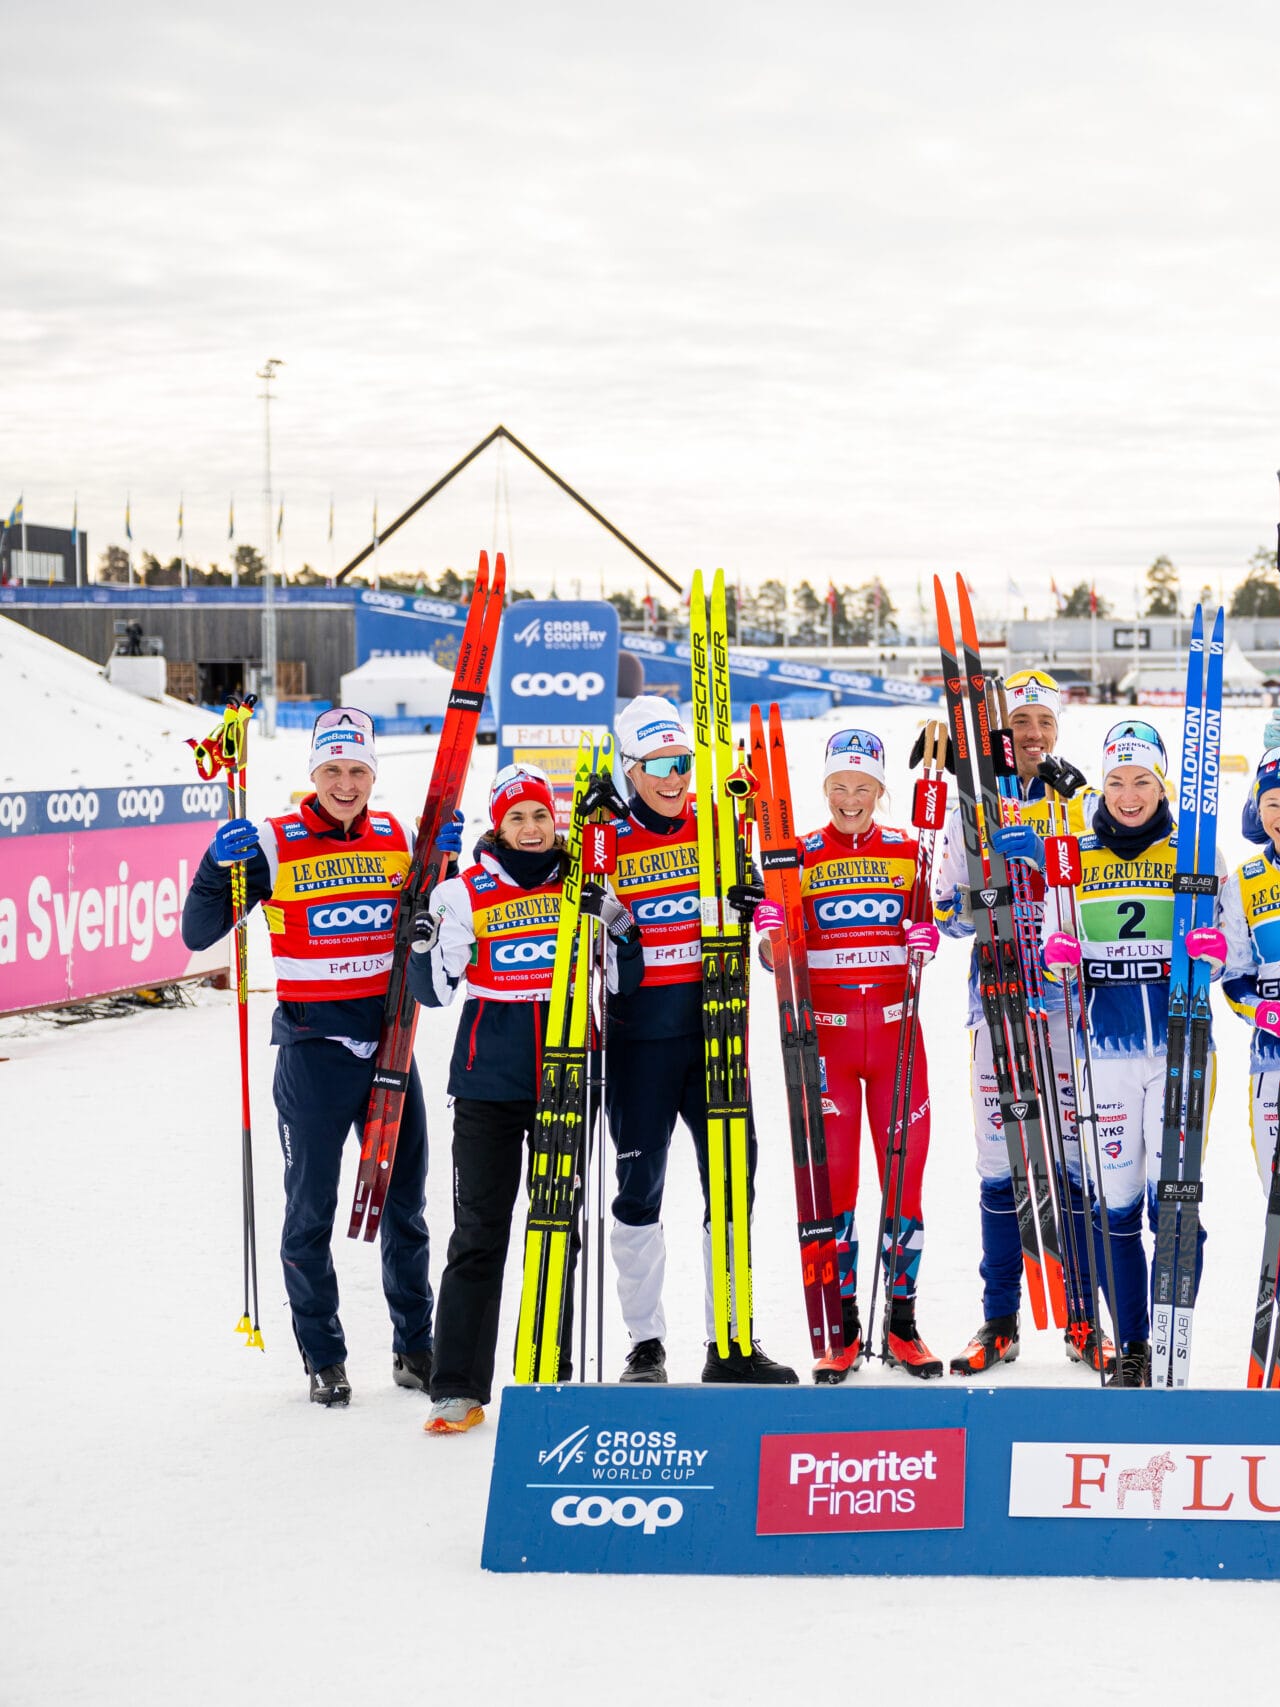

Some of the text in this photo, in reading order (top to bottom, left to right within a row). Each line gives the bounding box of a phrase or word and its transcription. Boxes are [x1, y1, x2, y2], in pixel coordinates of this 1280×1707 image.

[544, 620, 590, 633] CROSS
[544, 631, 607, 643] COUNTRY
[545, 642, 603, 651] WORLD CUP
[458, 642, 472, 684] ATOMIC
[474, 644, 489, 686] ATOMIC
[511, 671, 605, 701] coop
[694, 632, 709, 749] FISCHER
[713, 630, 730, 747] FISCHER
[456, 696, 479, 707] ATOMIC
[637, 721, 679, 741] SpareBank
[958, 702, 968, 760] ROSSIGNOL
[980, 698, 992, 757] ROSSIGNOL
[315, 732, 355, 750] SpareBank
[1182, 706, 1200, 812] SALOMON
[1202, 709, 1221, 816] SALOMON
[47, 784, 223, 828] coop coop coop
[778, 798, 791, 840] ATOMIC
[760, 800, 773, 841] ATOMIC
[292, 853, 386, 882] LE GRUYÈRE
[618, 845, 700, 877] LE GRUYÈR
[770, 855, 796, 865] ATOMIC
[809, 857, 889, 883] LE GRUYÈRE
[1083, 858, 1173, 884] LE GRUYÈRE
[298, 875, 386, 893] SWITZERLAND
[809, 876, 889, 889] SWITZERLAND
[1086, 880, 1170, 892] SWITZERLAND
[27, 858, 189, 962] Sverige!
[486, 893, 562, 923] LE GRUYÈR
[818, 898, 901, 923] coop
[1252, 891, 1267, 907] LE
[312, 903, 395, 929] coop
[1116, 901, 1147, 940] 2
[308, 938, 320, 946] FIS
[340, 936, 370, 944] COUNTRY
[703, 940, 743, 949] FISCHER
[544, 1051, 586, 1059] FISCHER
[1099, 1126, 1124, 1138] LYKO
[616, 1150, 635, 1161] CRAFT
[528, 1219, 570, 1227] FISCHER
[807, 1227, 833, 1236] ATOMIC
[596, 1431, 677, 1449] CROSS
[595, 1450, 709, 1468] COUNTRY
[789, 1449, 938, 1486] Prioritet
[591, 1467, 697, 1481] WORLD CUP
[808, 1482, 916, 1516] Finans
[550, 1495, 684, 1535] coop
